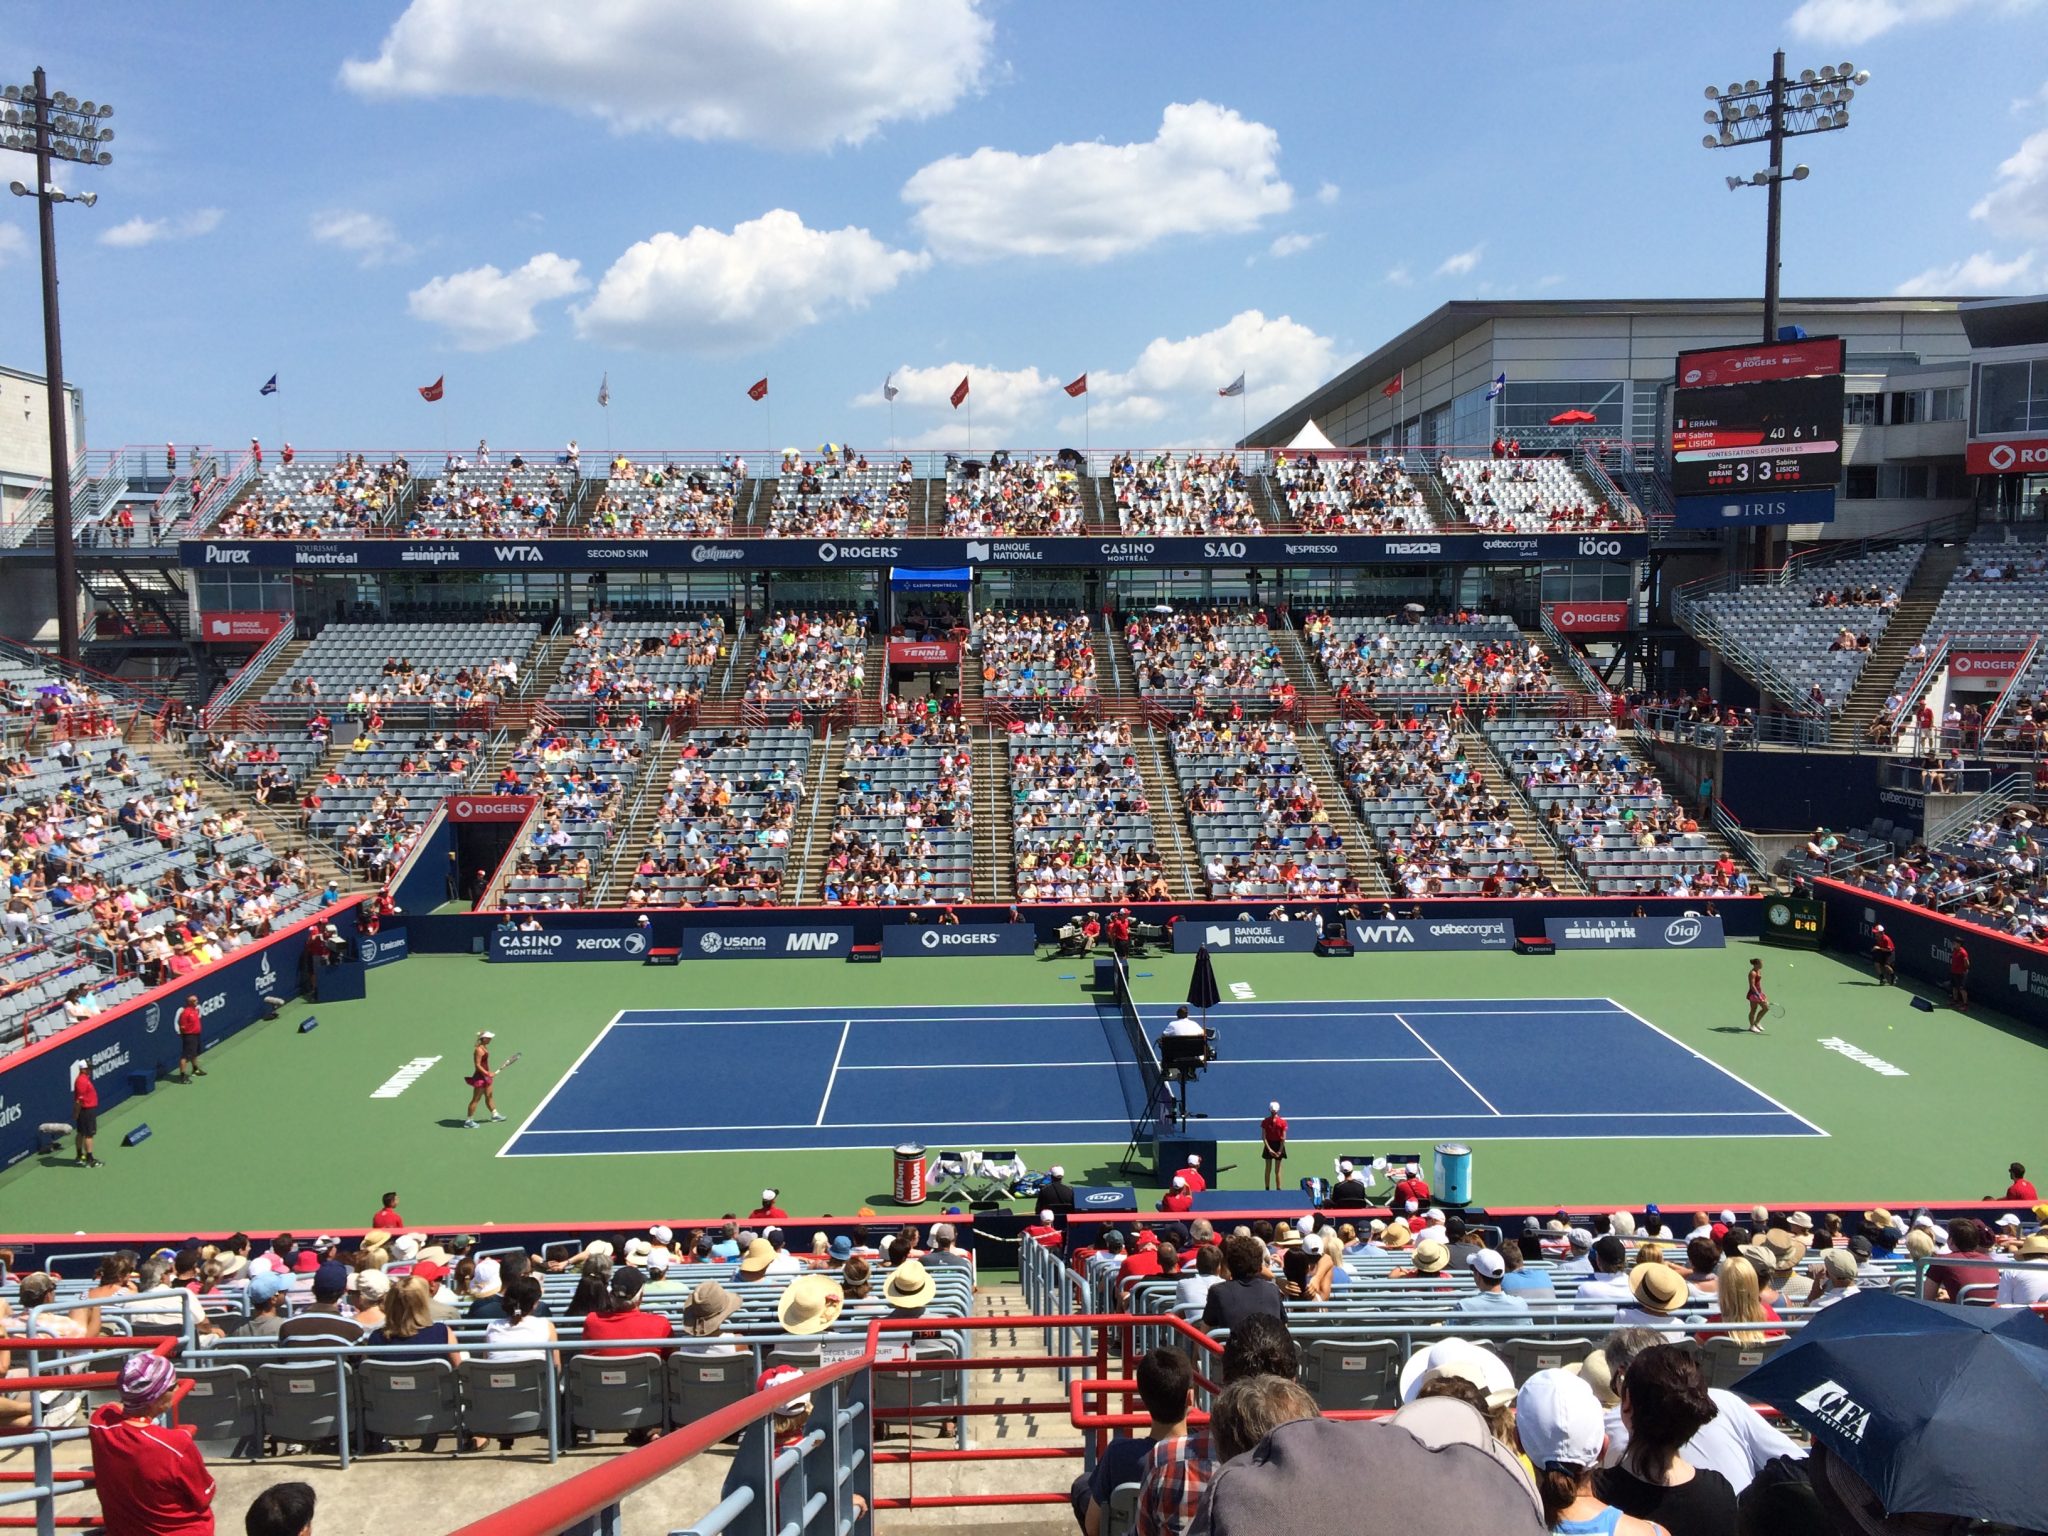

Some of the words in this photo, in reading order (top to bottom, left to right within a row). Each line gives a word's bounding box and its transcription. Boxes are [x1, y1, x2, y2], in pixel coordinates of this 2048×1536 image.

[1742, 359, 1777, 368] ROGERS
[1689, 419, 1718, 428] ERRANI
[1688, 431, 1714, 440] Sabine
[1769, 427, 1785, 439] 40
[1793, 426, 1802, 438] 6
[1812, 425, 1818, 437] 1
[1688, 439, 1716, 448] LISICKI
[1707, 449, 1759, 458] CONTESTATIONS
[1760, 445, 1804, 455] DISPONIBLES
[1718, 462, 1733, 470] Sara
[1736, 463, 1749, 481] 3
[1758, 461, 1772, 480] 3
[1775, 465, 1800, 473] LISICKI
[1708, 469, 1733, 477] ERRANI
[1744, 502, 1786, 517] IRIS
[840, 547, 899, 558] ROGERS
[993, 543, 1031, 551] BANQUE
[1101, 543, 1155, 554] CASINO
[1204, 542, 1247, 558] SAQ
[1285, 543, 1338, 554] NESPRESSO
[206, 545, 251, 563] Purex
[296, 551, 358, 564] Montréal
[494, 546, 544, 561] WTA
[587, 549, 626, 558] SECOND
[626, 549, 649, 558] SKIN
[993, 551, 1043, 560] NATIONALE
[1107, 554, 1149, 562] MONTRÉAL
[1577, 614, 1621, 623] ROGERS
[475, 804, 526, 814] ROGERS
[1234, 927, 1272, 936] BANQUE
[1356, 925, 1415, 943] WTA
[1668, 923, 1699, 937] Dial
[499, 935, 563, 948] CASINO
[576, 937, 622, 950] xerox
[723, 937, 767, 947] USANA
[786, 932, 839, 951] MNP
[942, 933, 998, 945] ROGERS
[1234, 936, 1285, 945] NATIONALE
[505, 947, 554, 956] MONTRÉAL
[2031, 972, 2048, 986] BAN
[91, 1041, 121, 1065] BANQUE
[92, 1050, 130, 1080] NATIONALE
[895, 1162, 905, 1199] Wilson
[910, 1161, 921, 1201] Wilson
[1818, 1391, 1872, 1439] CFA
[1817, 1411, 1862, 1445] INSTITUTE
